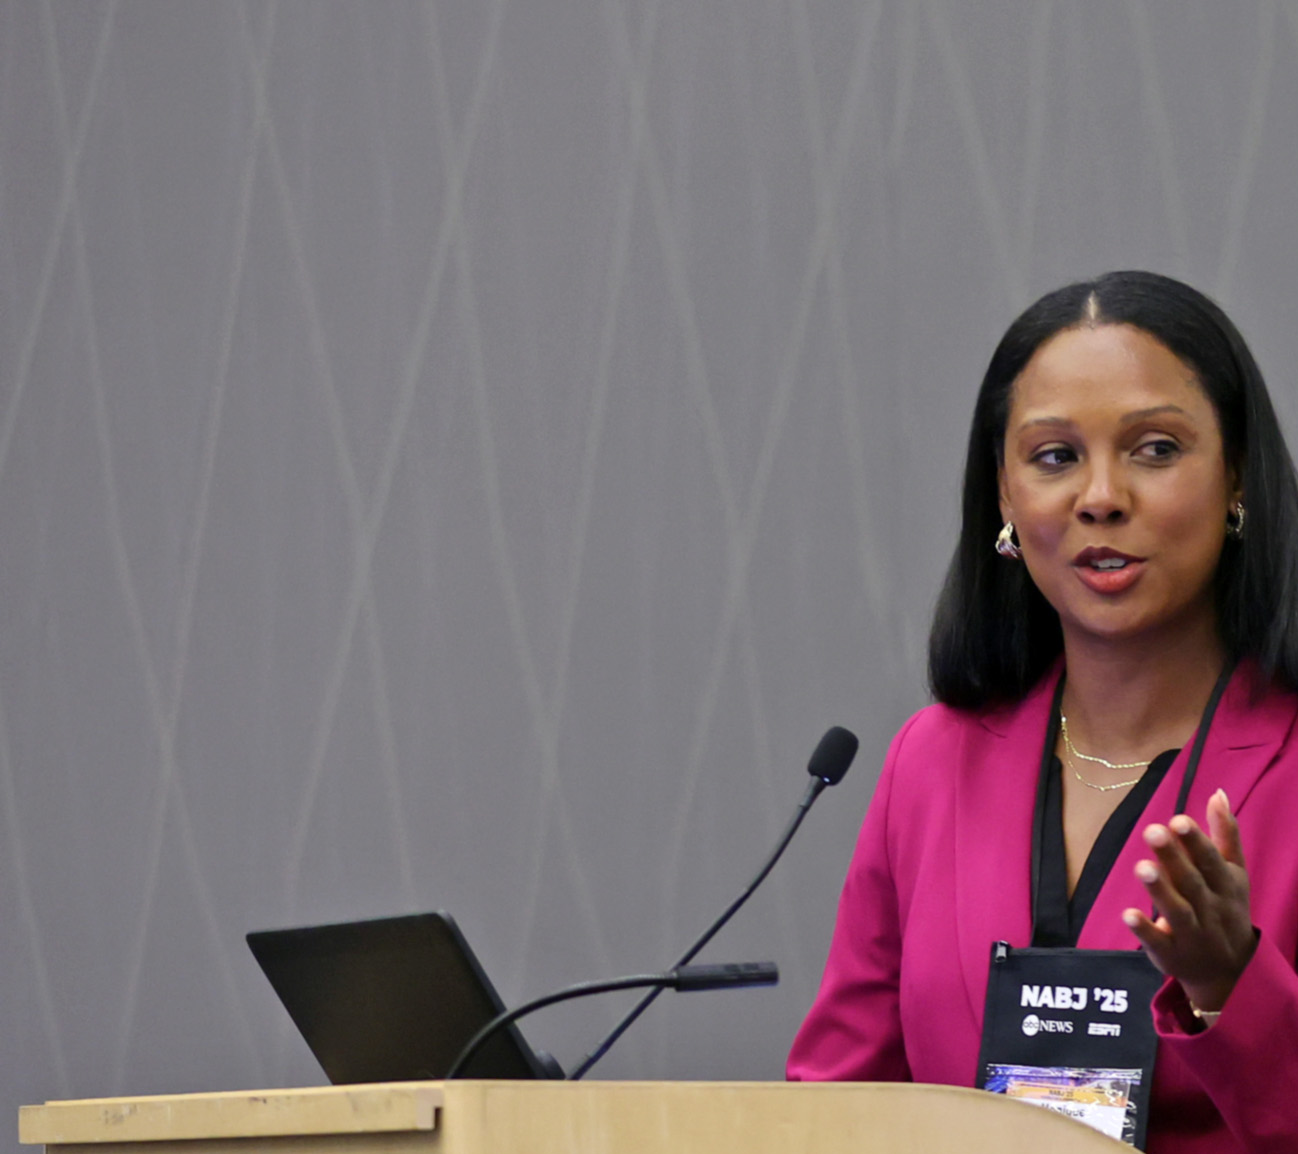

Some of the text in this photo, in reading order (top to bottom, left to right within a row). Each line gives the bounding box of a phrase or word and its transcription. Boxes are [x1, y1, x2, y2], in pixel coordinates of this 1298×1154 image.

[1020, 985, 1129, 1013] NABJ '25
[1039, 1020, 1074, 1033] NEWS
[1087, 1022, 1121, 1037] ESPN
